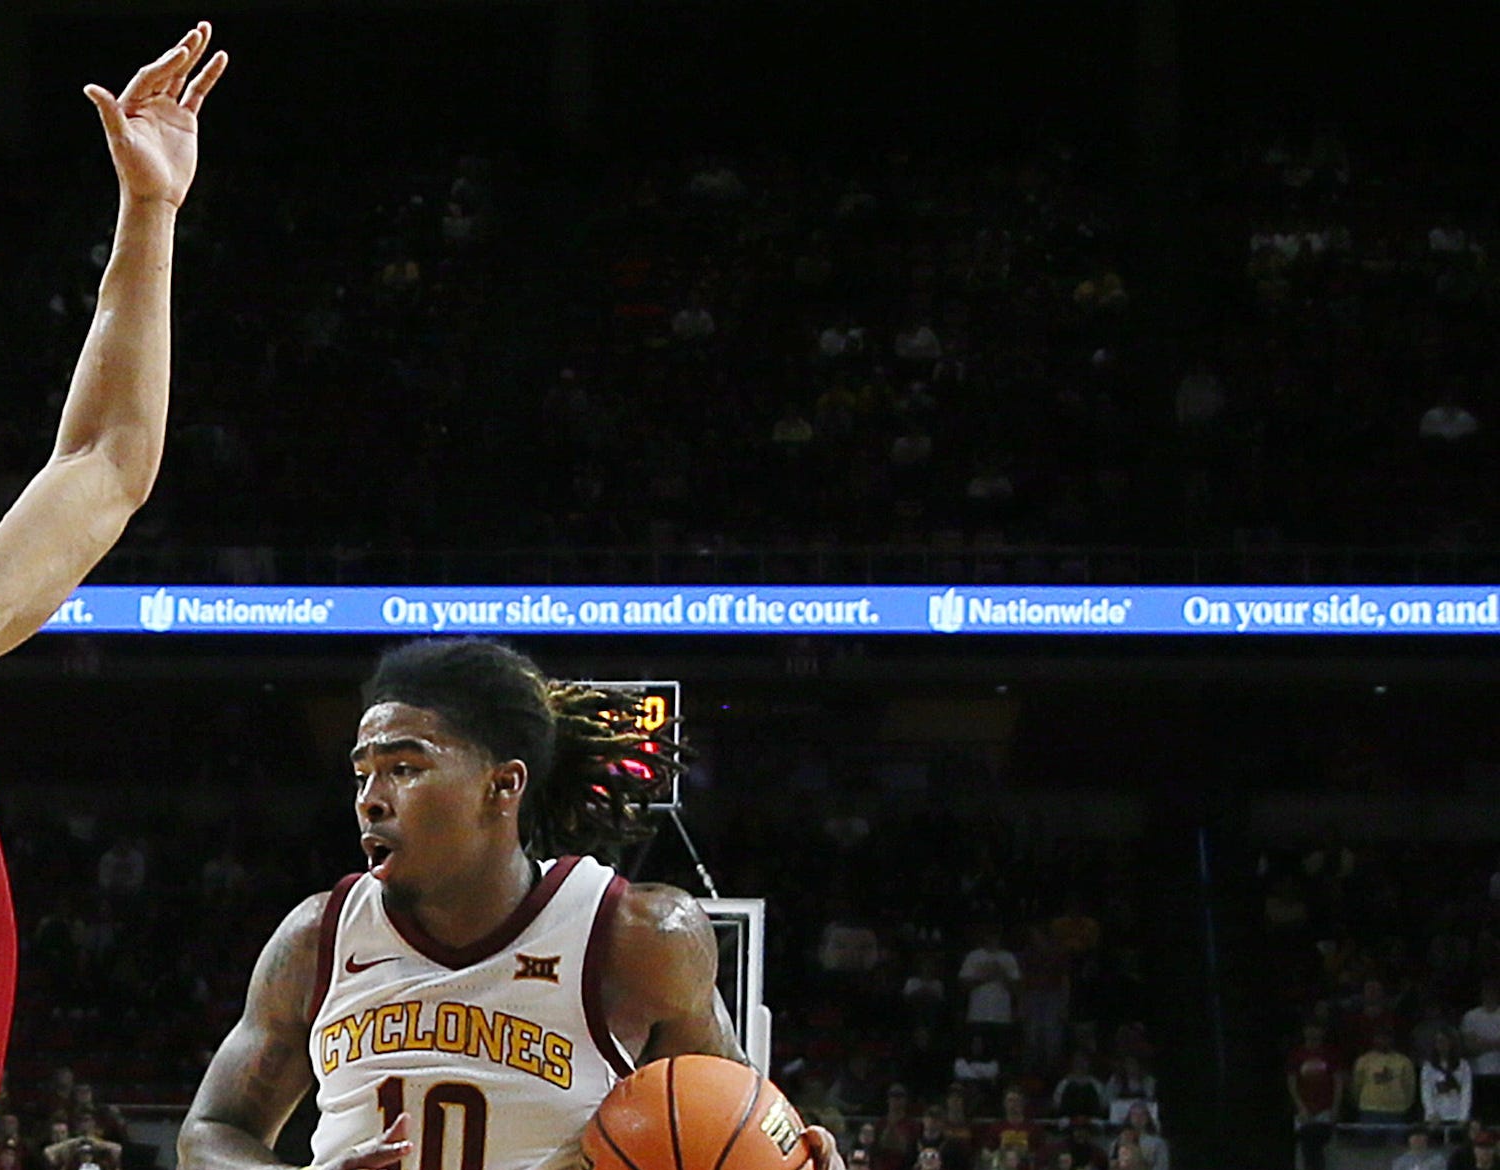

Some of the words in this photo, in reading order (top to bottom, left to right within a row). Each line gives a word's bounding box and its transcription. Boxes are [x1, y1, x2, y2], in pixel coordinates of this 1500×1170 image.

[178, 598, 327, 623] Nationwide
[382, 596, 427, 624] On
[431, 601, 502, 631] your
[505, 594, 576, 626] side,
[578, 601, 619, 624] on
[623, 594, 683, 624] and
[687, 594, 733, 624] off
[735, 594, 785, 624] the
[788, 597, 879, 624] court.
[968, 598, 1124, 624] Nationwide
[1183, 596, 1231, 624] On
[1234, 601, 1310, 631] your
[1312, 594, 1386, 627] side,
[1389, 601, 1432, 624] on
[1435, 594, 1498, 624] and
[319, 1000, 573, 1090] CYCLONES
